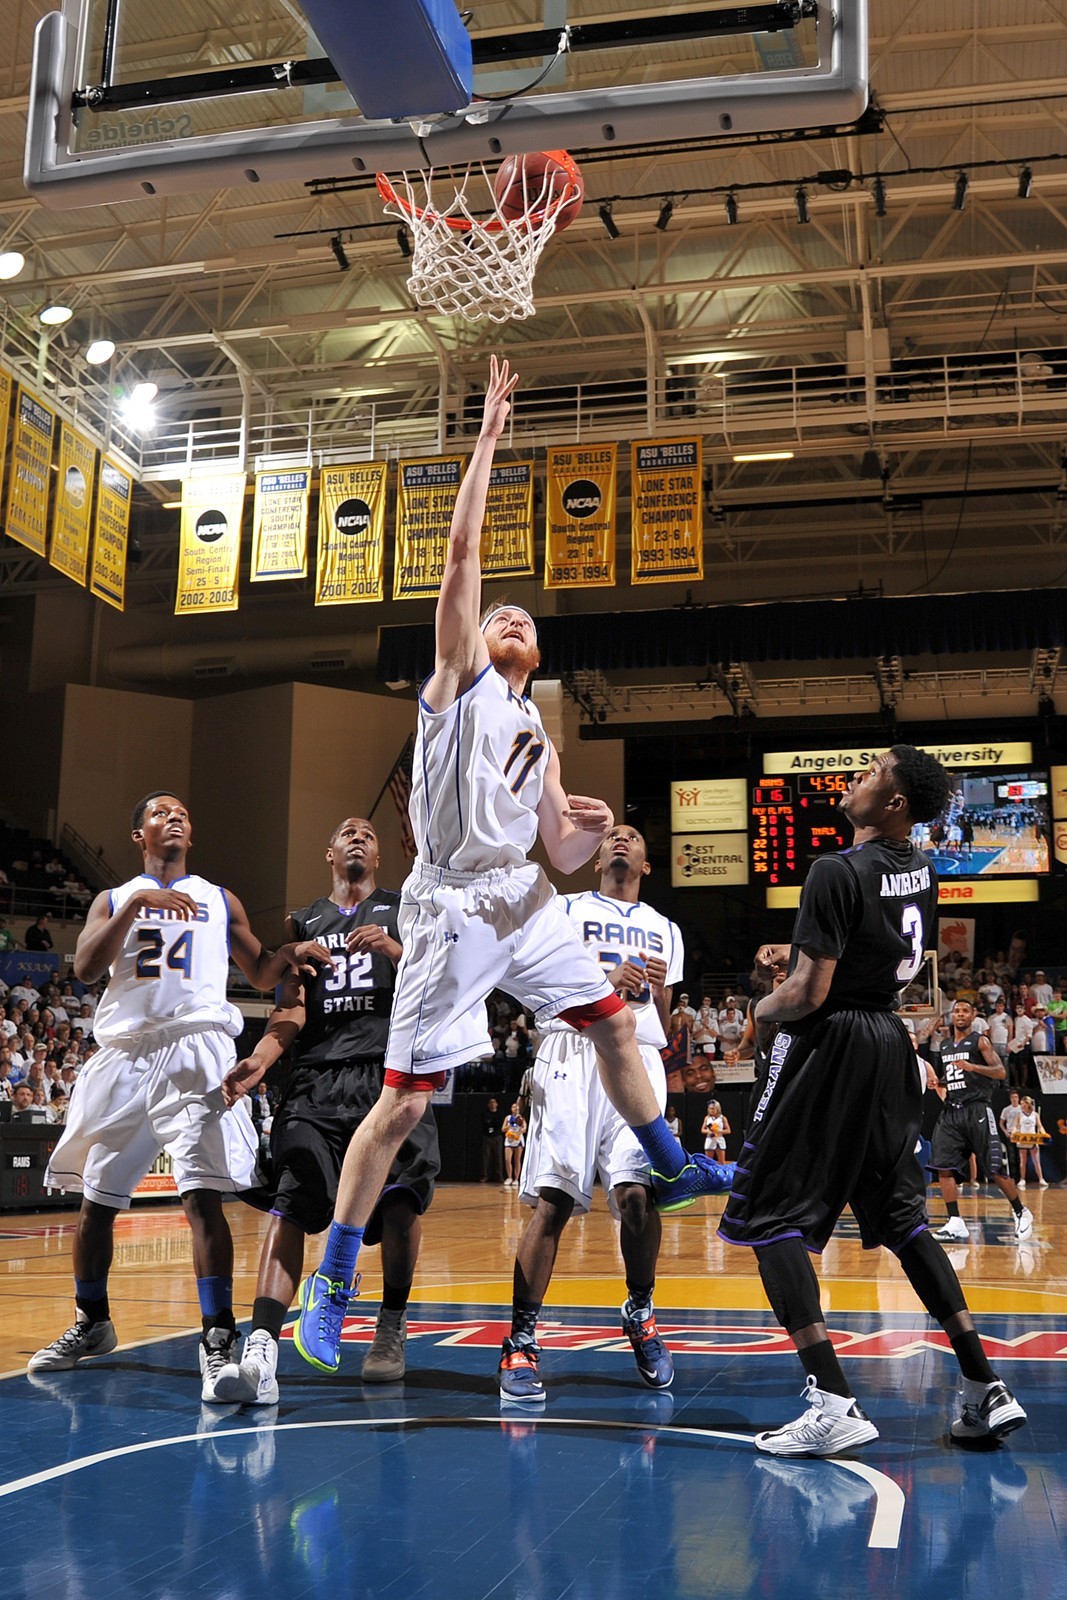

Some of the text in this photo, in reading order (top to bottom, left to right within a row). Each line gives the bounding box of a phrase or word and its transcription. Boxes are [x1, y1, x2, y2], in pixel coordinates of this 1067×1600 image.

[553, 454, 572, 466] ASU
[640, 448, 659, 459] ASU
[641, 456, 693, 467] BASKETBALL
[406, 467, 423, 478] ASU
[262, 476, 277, 485] ASU
[326, 473, 344, 486] ASU
[406, 475, 455, 485] BASKETBALL
[641, 476, 693, 493] LONE STAR
[407, 494, 456, 510] LONE STAR
[566, 497, 600, 510] NCAA
[636, 492, 697, 509] CONFERENCE
[271, 515, 294, 523] SOUTH
[337, 514, 371, 528] NCAA
[493, 514, 517, 523] SOUTH
[642, 508, 692, 525] CHAMPION
[263, 523, 300, 532] CHAMPION
[407, 526, 451, 541] CHAMPIO
[493, 522, 530, 533] CHAMPION
[552, 521, 611, 534] South Central
[566, 535, 595, 545] Region
[184, 548, 205, 557] South
[640, 546, 696, 563] 1993-1994
[196, 556, 222, 566] Region
[186, 565, 230, 576] Semi-Finals
[400, 564, 446, 579] 2001-20
[552, 565, 609, 581] 1993-1994
[322, 581, 379, 597] 2001-2002
[180, 590, 234, 606] 2002-2003
[503, 729, 546, 796] 11
[791, 755, 853, 769] Angelo
[928, 747, 1004, 763] iversity
[759, 778, 785, 787] RAMS
[810, 775, 846, 791] 4:56
[938, 886, 973, 899] ena
[583, 920, 663, 954] RAMS
[895, 902, 923, 982] 3
[136, 927, 195, 980] 24
[324, 951, 374, 991] 32
[323, 995, 375, 1014] STATE
[754, 1032, 792, 1122] TEXANS
[947, 1080, 967, 1091] STATE
[13, 1156, 31, 1168] RAMS
